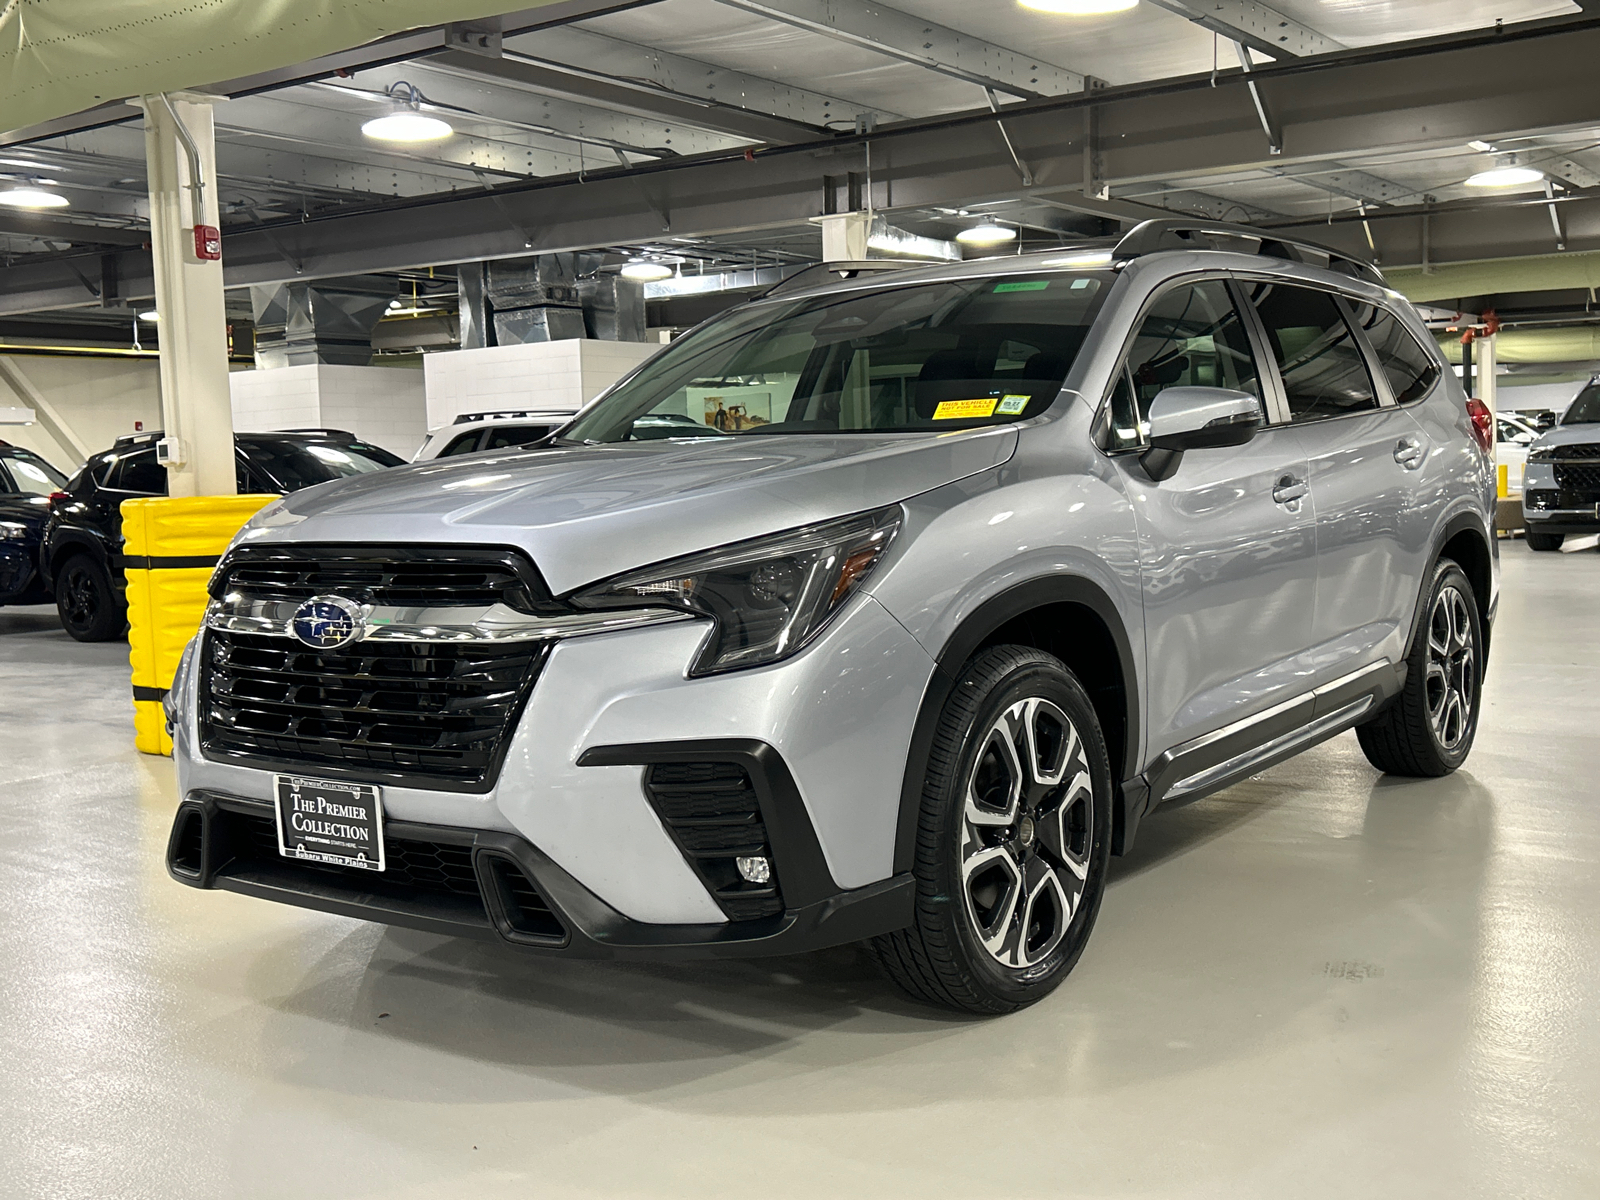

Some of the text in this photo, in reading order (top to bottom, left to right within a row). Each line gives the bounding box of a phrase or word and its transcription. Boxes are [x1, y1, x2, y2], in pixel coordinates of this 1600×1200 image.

[290, 792, 368, 820] THE PREMIER
[291, 812, 369, 841] COLLECTION
[304, 835, 331, 845] EVERYTHING
[295, 850, 368, 869] Subaru White Plains
